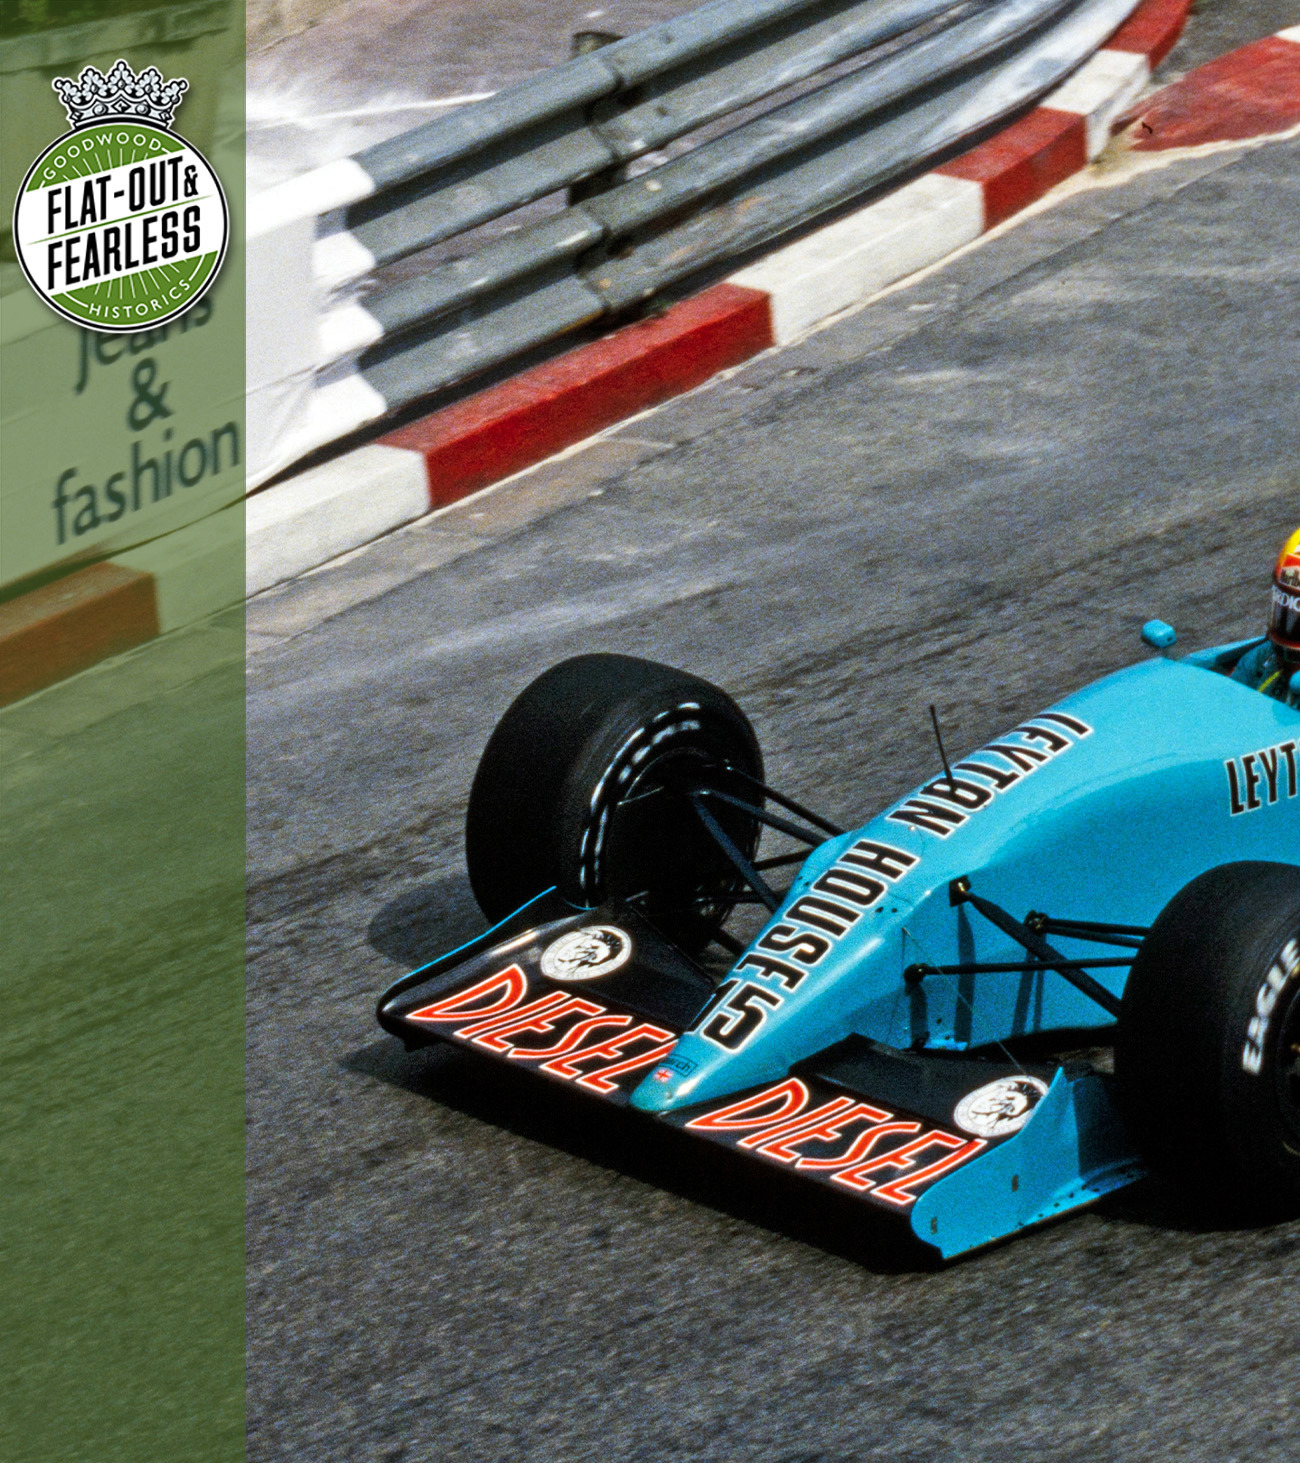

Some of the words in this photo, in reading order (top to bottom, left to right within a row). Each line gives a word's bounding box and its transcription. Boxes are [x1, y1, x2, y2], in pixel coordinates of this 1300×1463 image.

[127, 357, 174, 432] &
[53, 420, 242, 546] fashion
[735, 840, 920, 994] HOUSE
[405, 963, 680, 1094] DIESEL
[1242, 938, 1300, 1075] EAGLE
[685, 1076, 988, 1205] DIESEL
